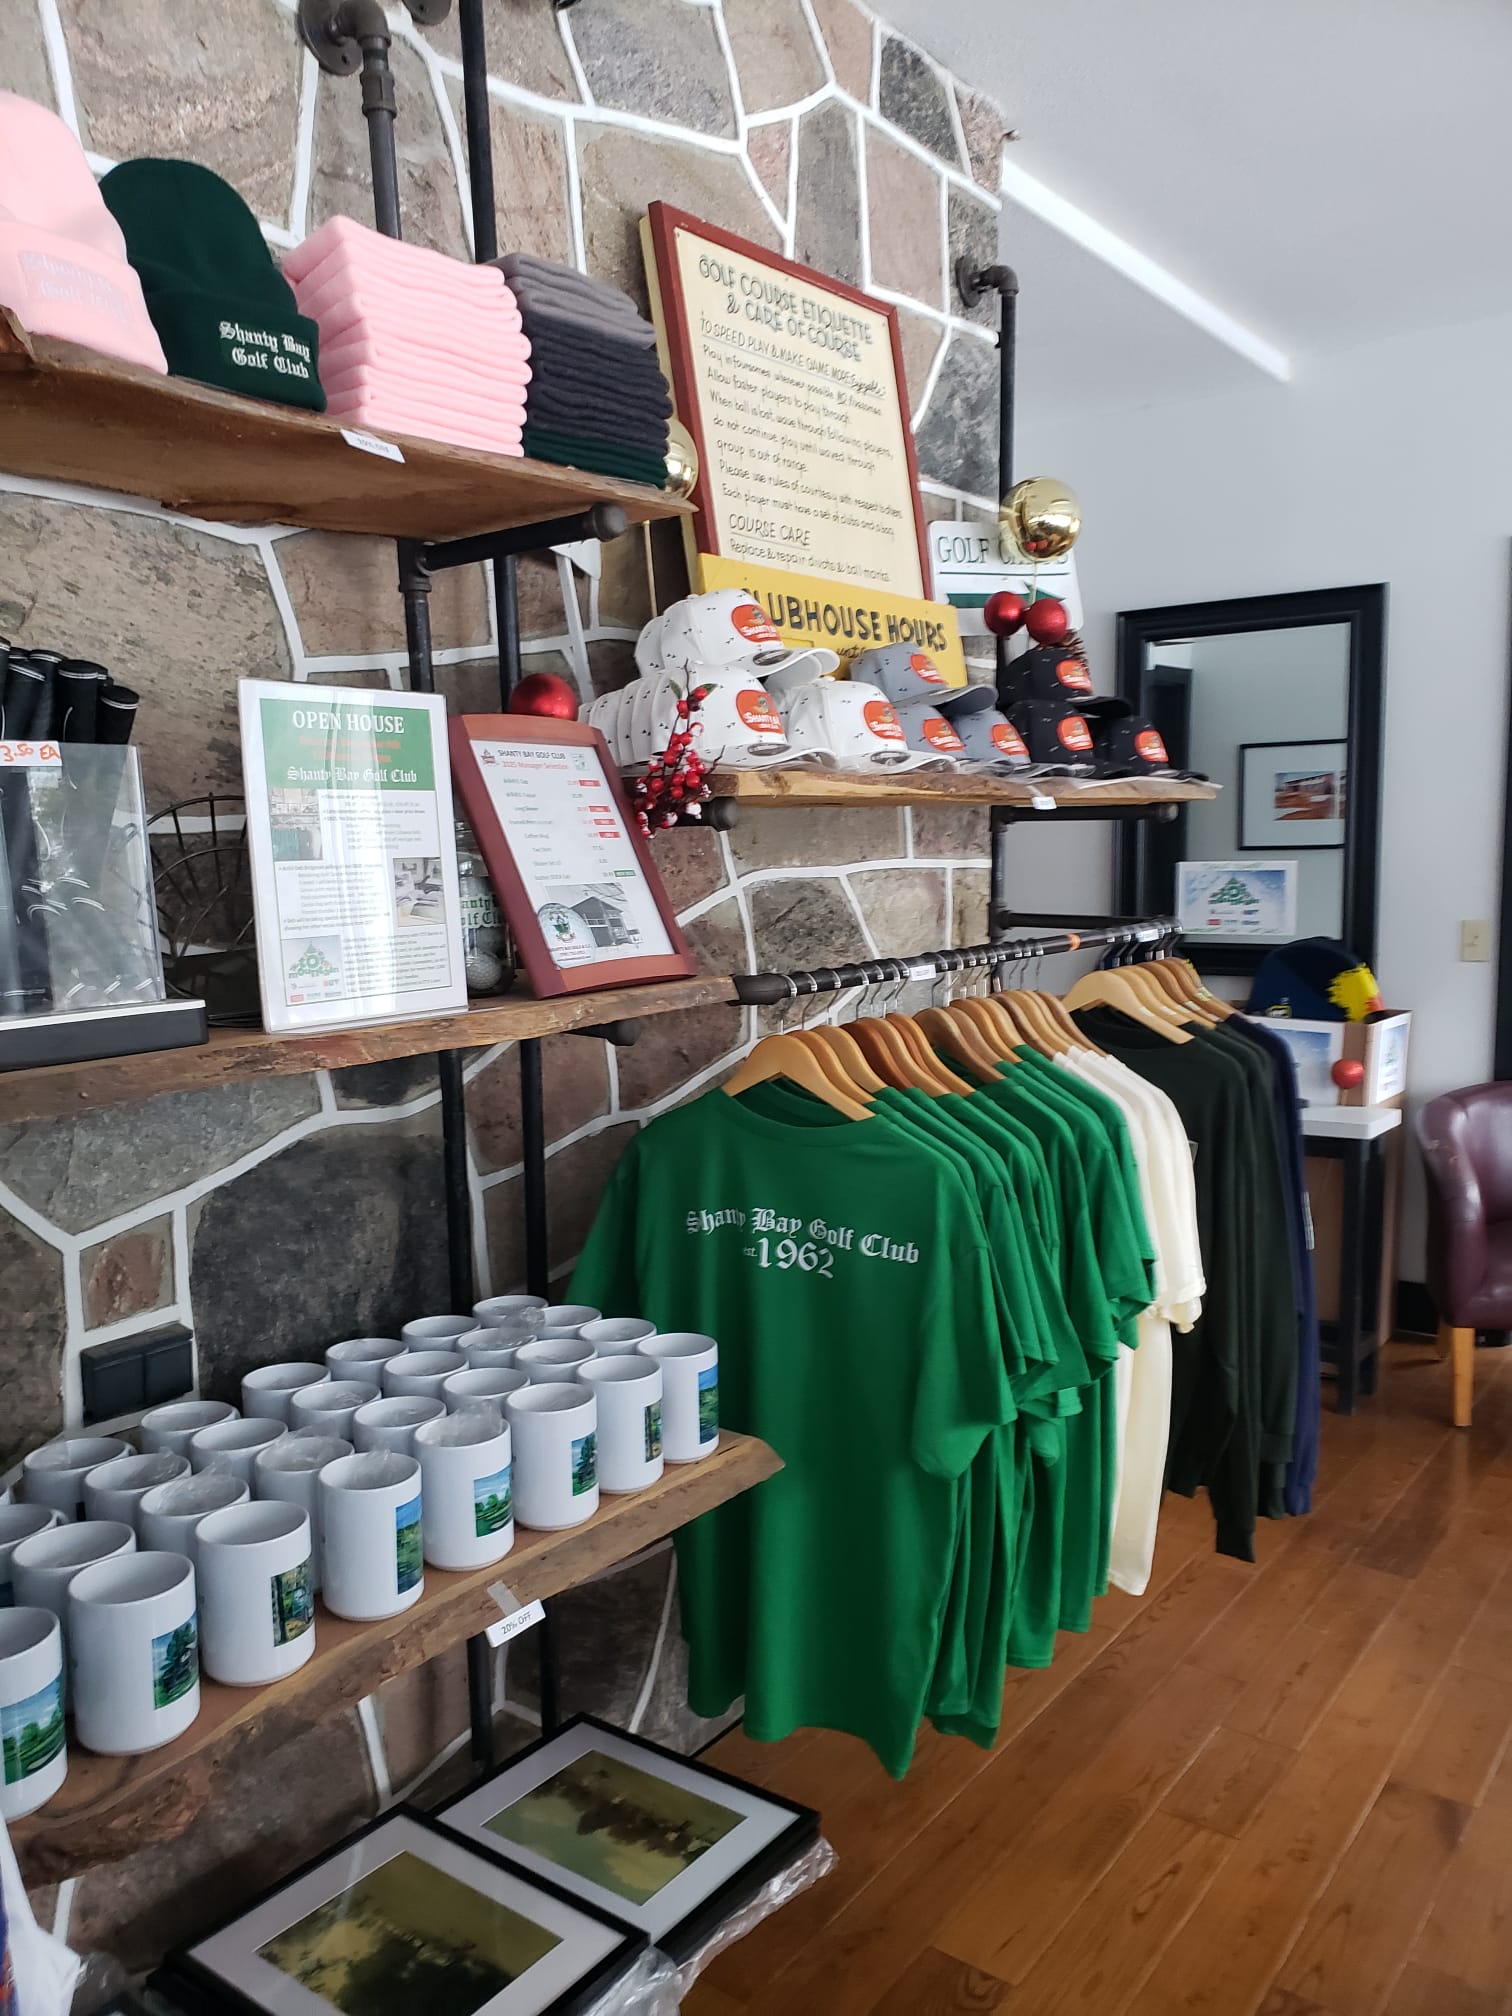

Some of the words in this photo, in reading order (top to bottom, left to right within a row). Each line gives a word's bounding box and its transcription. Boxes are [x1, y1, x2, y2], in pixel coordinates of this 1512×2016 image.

[698, 257, 735, 289] GOLF
[739, 272, 798, 315] COURSE
[801, 298, 872, 345] ETIQUETTE
[712, 322, 746, 347] SPEED
[747, 335, 770, 355] PLAY
[725, 292, 740, 315] &
[744, 301, 783, 332] CARE
[787, 317, 806, 339] OF
[807, 324, 861, 362] COURSE
[218, 320, 278, 353] Shanty
[282, 334, 310, 363] Bay
[232, 346, 268, 370] Golf
[274, 355, 310, 378] Club
[703, 343, 722, 366] Play
[707, 366, 731, 384] Allow
[710, 390, 732, 408] When
[716, 439, 745, 460] group
[719, 458, 750, 479] Please
[729, 512, 776, 538] COURSE
[780, 524, 811, 546] CARE
[938, 536, 990, 564] GOLF
[741, 588, 883, 641] UBHOUSE
[886, 613, 948, 653] HOURS
[292, 710, 342, 730] OPEN
[346, 713, 405, 734] HOUSE
[40, 744, 60, 760] EA
[288, 766, 331, 782] Shanty
[334, 767, 360, 782] Bay
[362, 768, 388, 783] Golf
[390, 769, 417, 783] Club
[461, 897, 491, 911] anty
[461, 912, 479, 926] olf
[752, 1208, 802, 1238] Bay
[809, 1218, 856, 1250] Golf
[860, 1232, 920, 1264] Club
[757, 1237, 834, 1278] 1962
[501, 1620, 518, 1635] 20%
[518, 1611, 532, 1625] OFF
